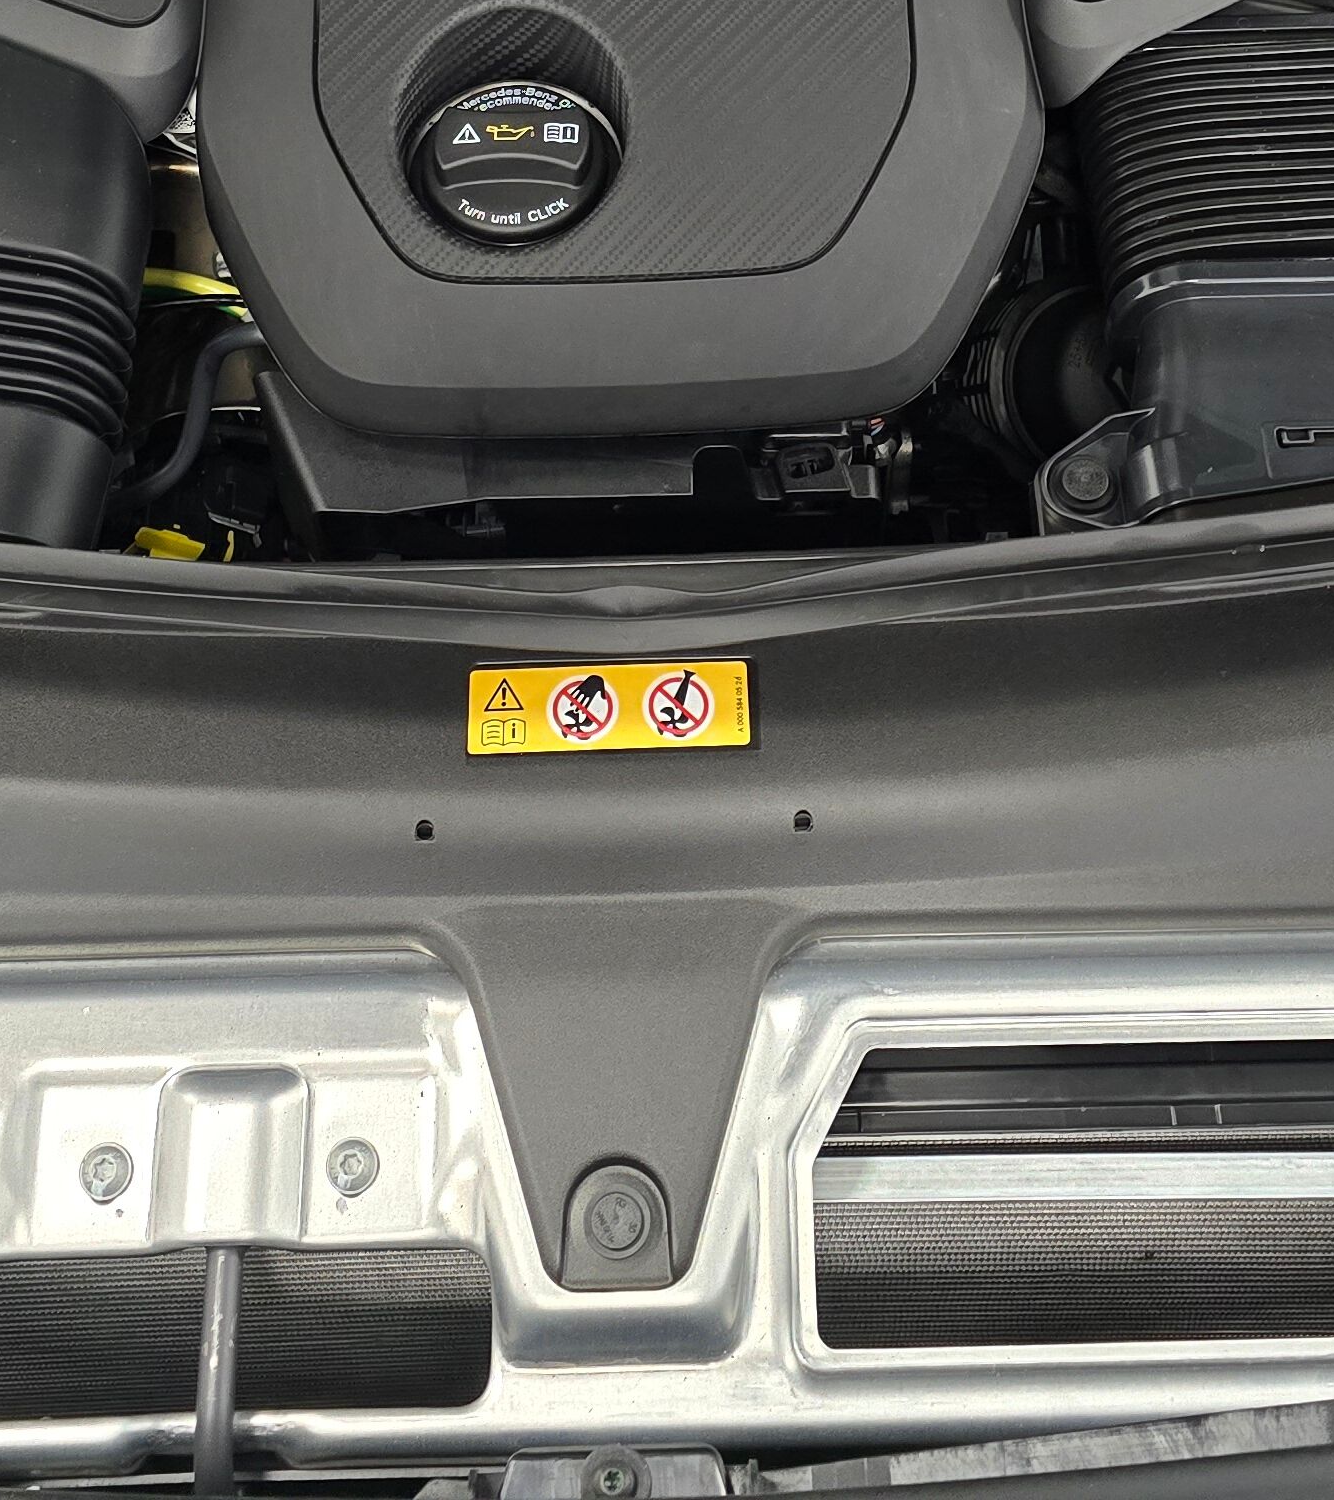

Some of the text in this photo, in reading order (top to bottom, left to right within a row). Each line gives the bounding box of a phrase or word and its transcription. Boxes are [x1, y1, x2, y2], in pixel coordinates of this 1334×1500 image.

[456, 86, 559, 111] Mercedes-Benz
[457, 197, 570, 225] Turn until CLICK
[736, 712, 744, 726] 000
